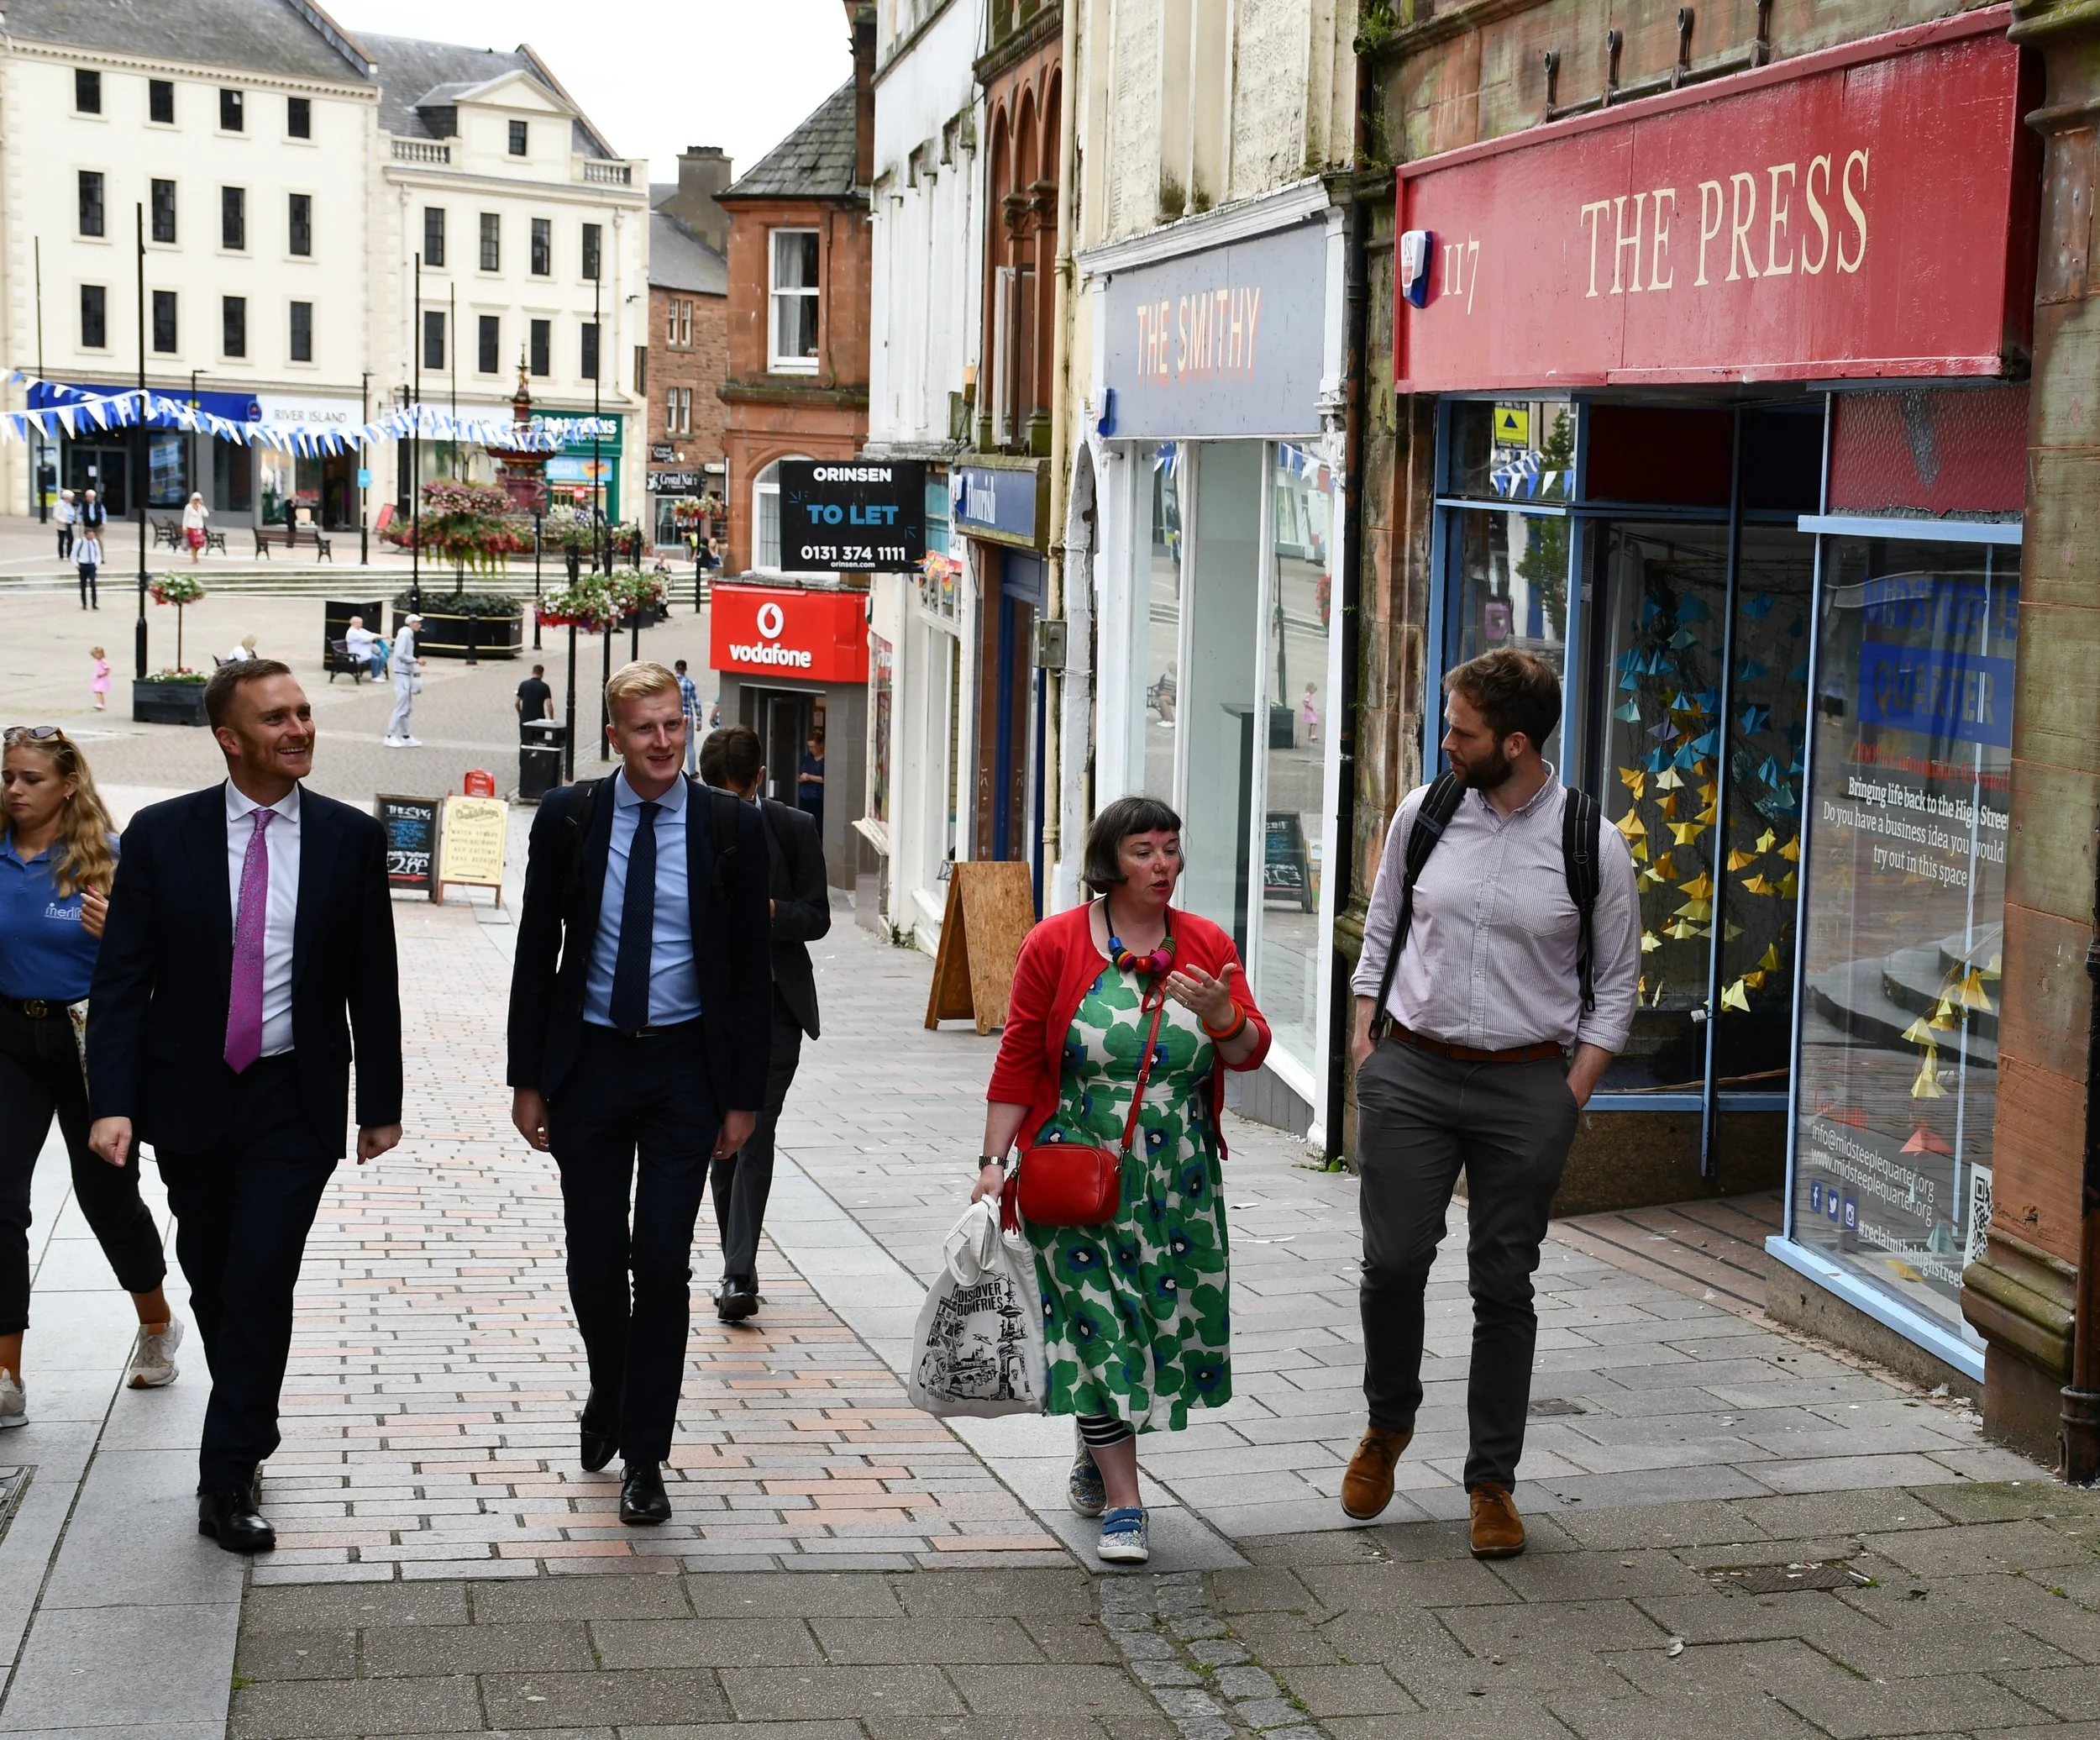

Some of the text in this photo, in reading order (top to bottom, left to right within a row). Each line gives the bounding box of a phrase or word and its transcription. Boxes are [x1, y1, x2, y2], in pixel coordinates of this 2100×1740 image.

[1580, 147, 1870, 299] THE PRESS
[1442, 233, 1480, 315] 117
[1137, 286, 1260, 376] THE SMITHY
[274, 409, 304, 421] RIVER
[308, 412, 348, 423] ISLAND
[813, 467, 892, 482] ORINSEN
[806, 504, 900, 525] TO LET
[801, 544, 906, 561] 0131 374 1111
[830, 560, 876, 570] orinsen.com
[729, 641, 812, 669] vodafone
[1872, 658, 1995, 726] QUARTER
[1848, 776, 1887, 808] Bringing
[1887, 783, 1903, 807] life
[1903, 786, 1926, 812] back
[1927, 794, 1937, 814] to
[1937, 795, 1955, 819] the
[1823, 801, 1835, 822] Do
[1836, 807, 1853, 828] you
[1855, 807, 1877, 833] have
[1877, 817, 1884, 833] a
[1885, 813, 1926, 844] business
[1928, 823, 1949, 849] idea
[1950, 835, 1969, 857] you
[1873, 844, 1967, 888] try out in this space
[1812, 1120, 1935, 1203] info@midsteeplequarter.org
[1811, 1148, 1932, 1227] www.midsteeplequarter.org
[1858, 1219, 1963, 1288] #reclaimthehighstreet
[957, 1296, 1004, 1317] DUMFRIES
[958, 1281, 1002, 1303] DISCOVER
[927, 1385, 955, 1403] GUILD
